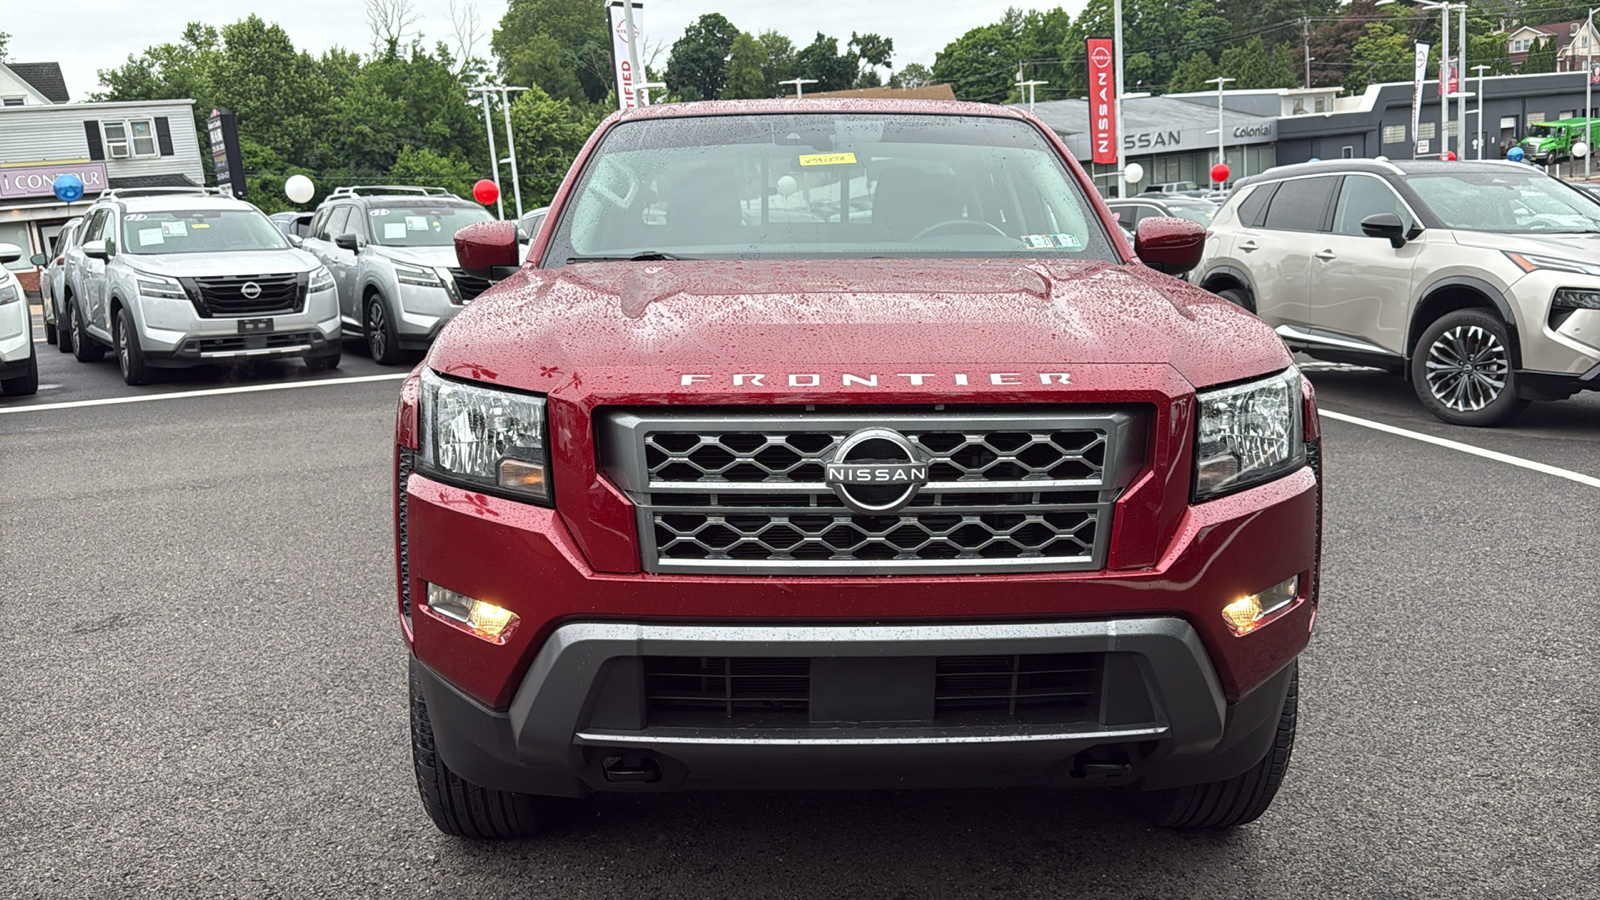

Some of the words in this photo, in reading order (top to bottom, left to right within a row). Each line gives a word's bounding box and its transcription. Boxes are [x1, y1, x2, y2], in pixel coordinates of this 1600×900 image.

[621, 60, 635, 109] TIFIED
[1098, 73, 1109, 153] NISSAN
[1123, 130, 1181, 149] SSAN
[1233, 124, 1272, 138] Colonial
[15, 171, 100, 190] CONUR
[680, 373, 1073, 387] FRONTIER
[829, 467, 925, 481] NISSAN
